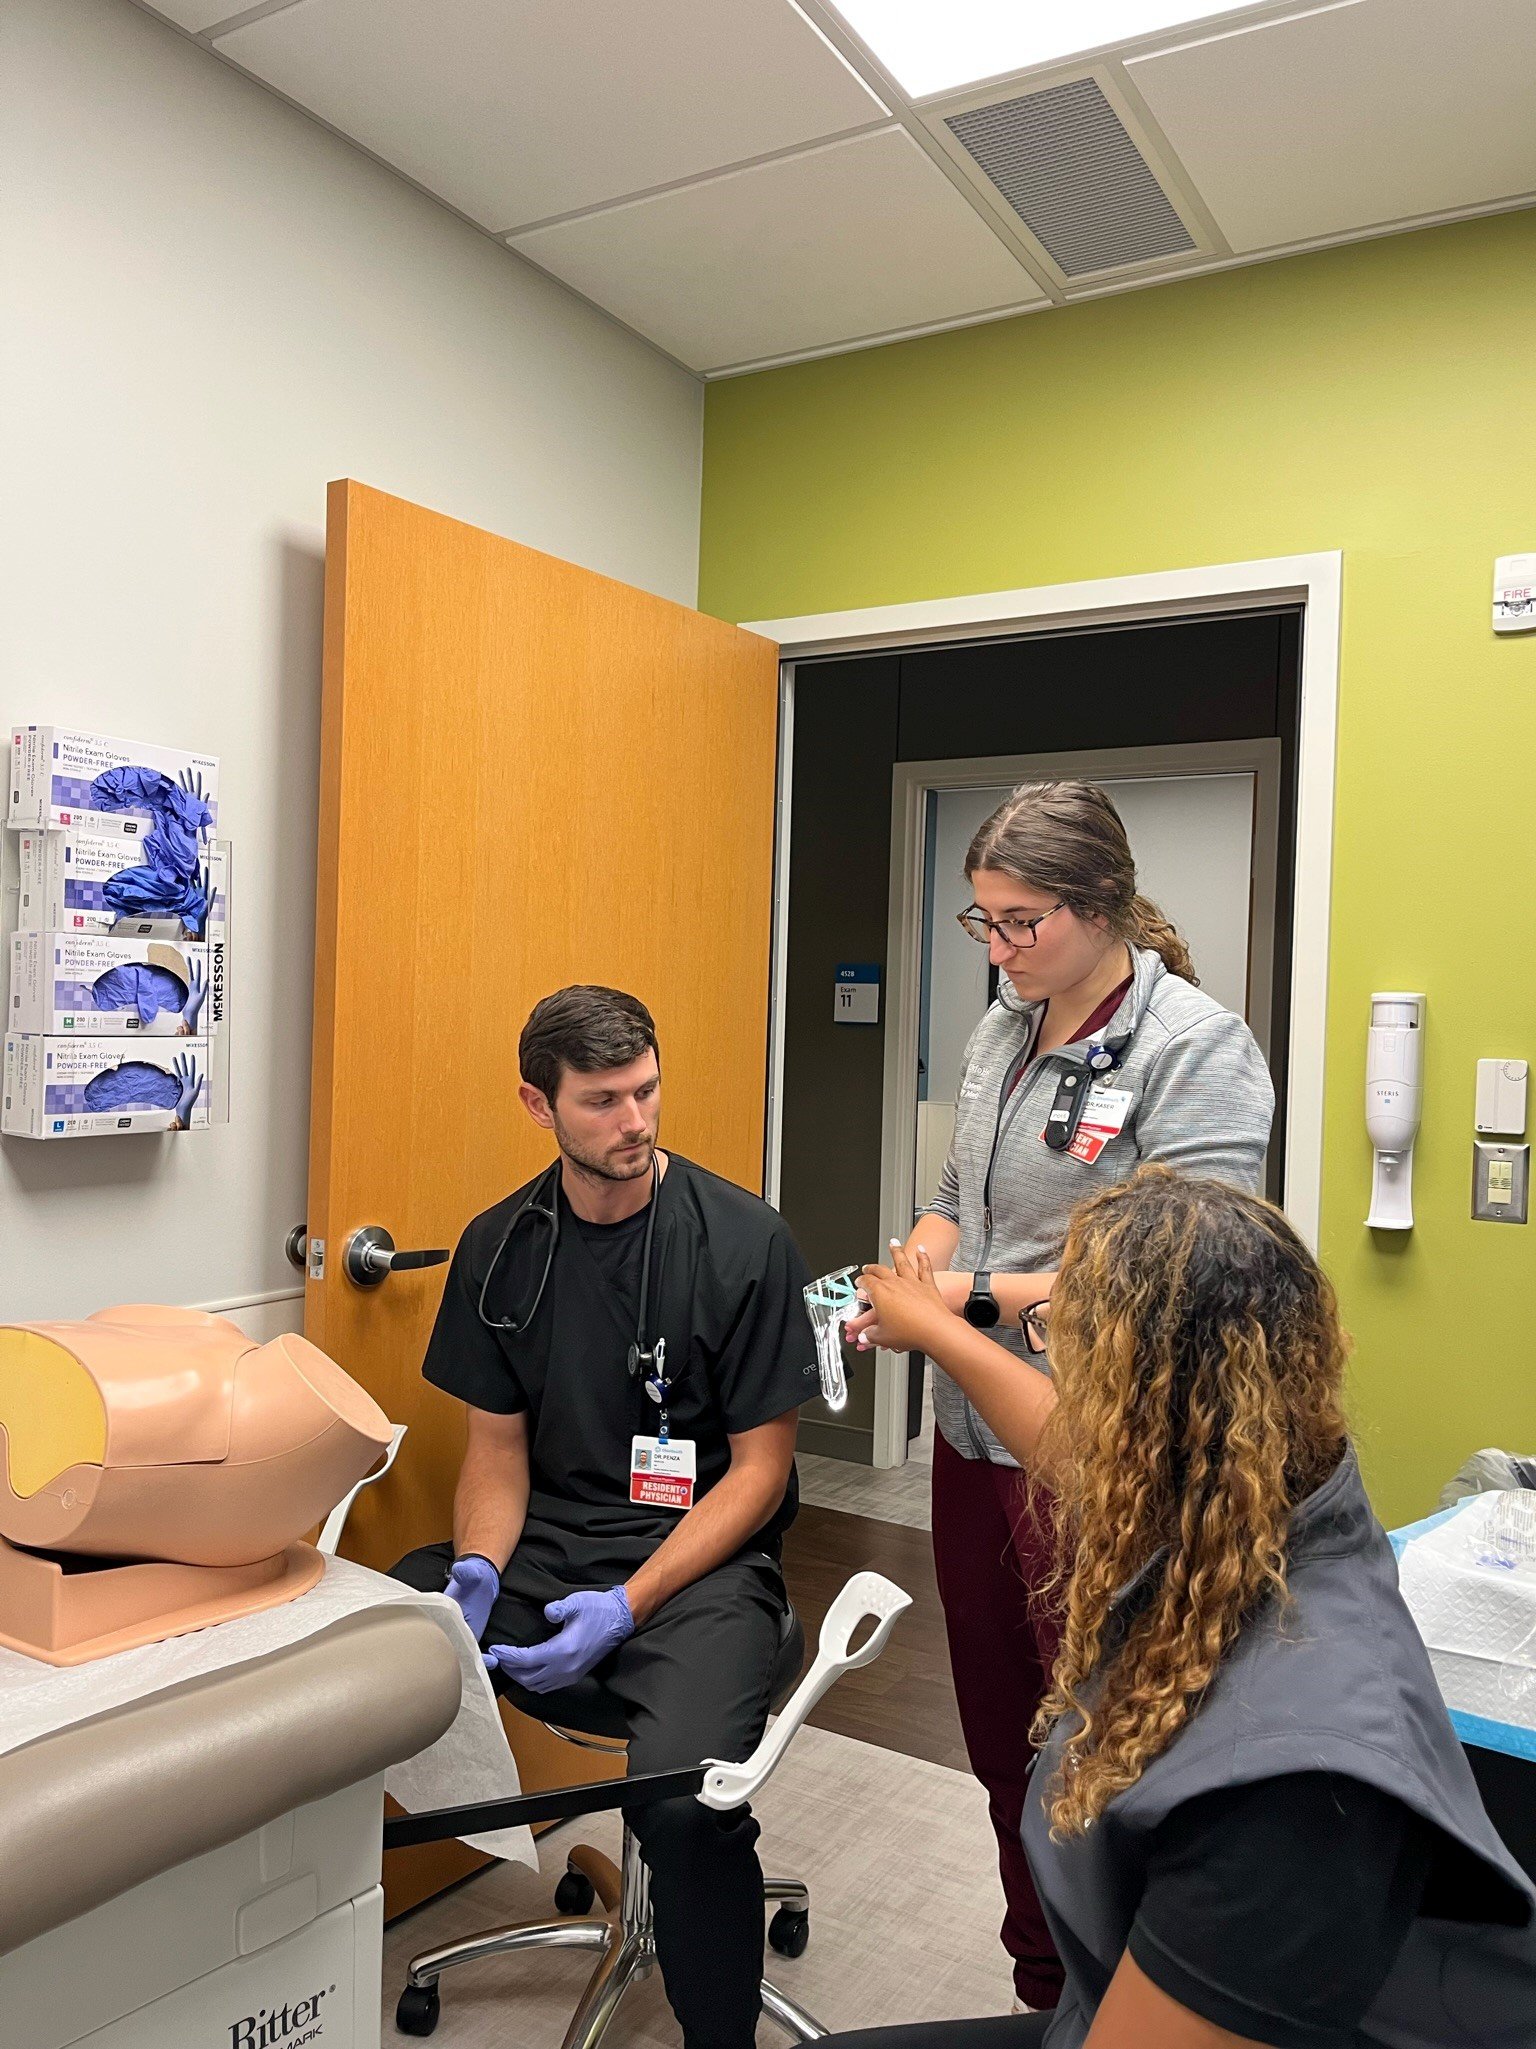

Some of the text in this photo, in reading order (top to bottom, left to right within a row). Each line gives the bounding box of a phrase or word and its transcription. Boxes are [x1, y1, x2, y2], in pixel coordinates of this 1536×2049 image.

[1503, 588, 1531, 600] FIRE
[63, 744, 130, 762] Nitrile Exam Gloves
[63, 754, 113, 768] POWDER-FREE
[75, 847, 141, 862] Nitrile Exam Gloves
[75, 857, 125, 869] POWDER-FREE
[86, 950, 106, 958] Exam
[107, 951, 132, 959] Gloves
[65, 959, 115, 967] POWDER-FREE
[841, 994, 851, 1007] 11
[100, 1052, 125, 1060] Gloves
[642, 1481, 681, 1494] RESIDENT
[640, 1490, 682, 1504] PHYSICIAN
